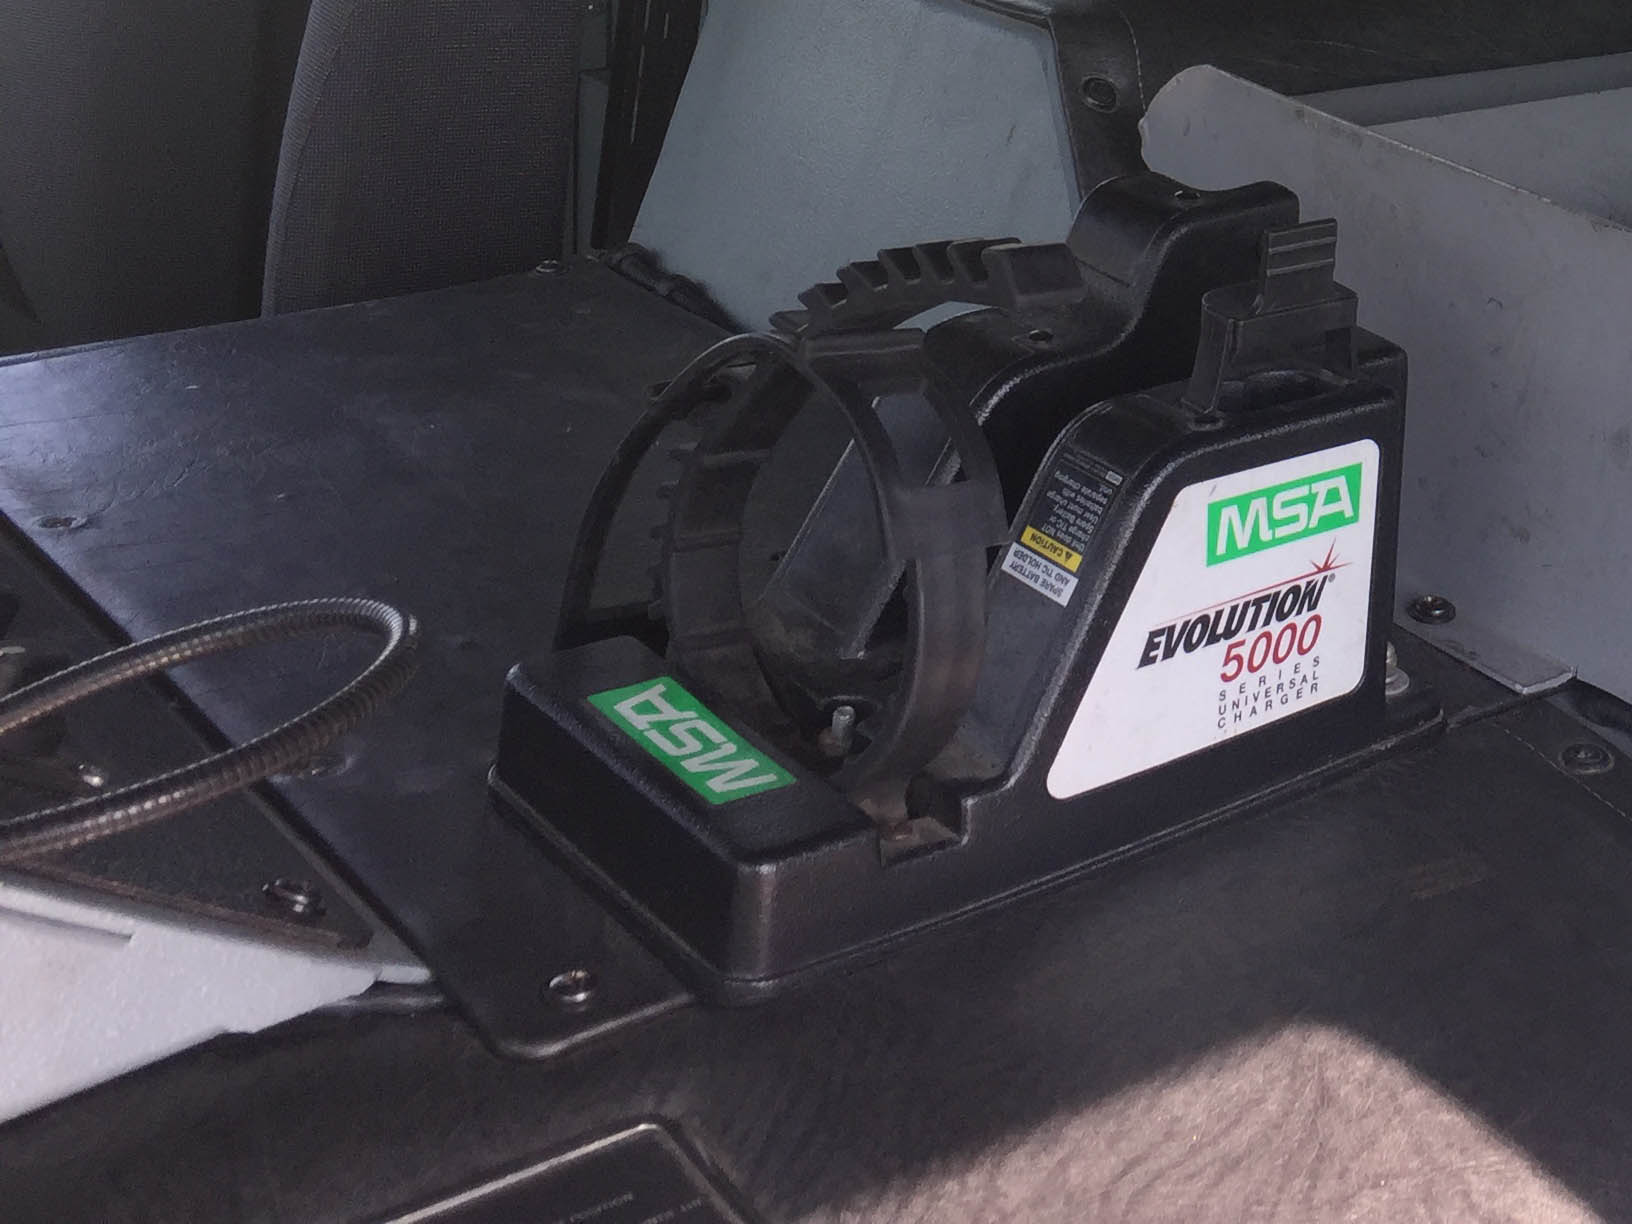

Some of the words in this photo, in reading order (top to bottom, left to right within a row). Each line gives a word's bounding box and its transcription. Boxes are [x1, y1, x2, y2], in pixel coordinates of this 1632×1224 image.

[1216, 476, 1354, 556] MSA
[1013, 548, 1042, 570] HOLDER
[1030, 532, 1064, 557] CAUTION
[1009, 559, 1040, 582] BATTERY
[1039, 578, 1063, 596] SPARE
[1041, 565, 1055, 576] TIC
[1054, 572, 1070, 585] AND
[1136, 573, 1328, 670] EVOLUTION
[1220, 614, 1322, 683] 5000
[1218, 672, 1319, 716] UNIVERSAL
[1219, 656, 1319, 701] SERIES
[1217, 684, 1318, 729] CHARGER
[614, 683, 777, 793] MSA
